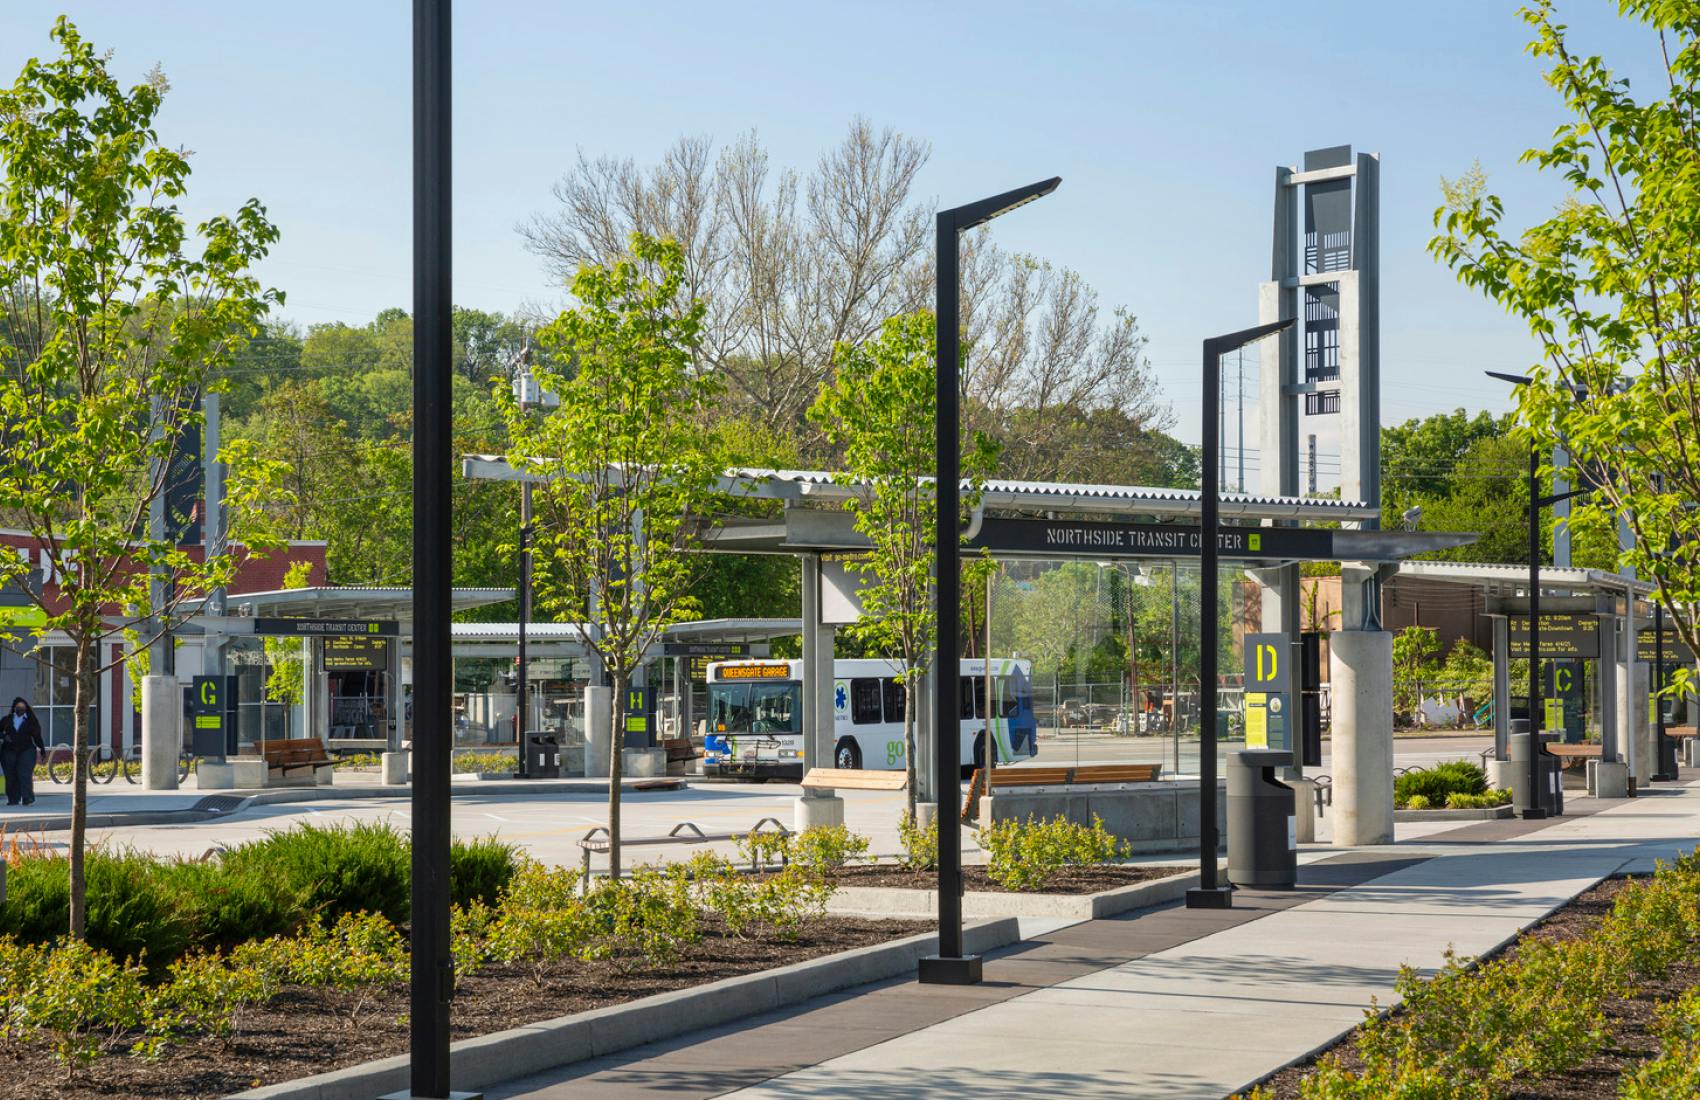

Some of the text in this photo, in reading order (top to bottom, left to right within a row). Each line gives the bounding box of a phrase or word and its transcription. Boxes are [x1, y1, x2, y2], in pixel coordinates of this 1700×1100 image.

[1046, 528, 1124, 546] NORTHSIDE
[1128, 530, 1186, 548] TRANSIT
[1189, 532, 1242, 549] CTER
[722, 665, 788, 679] QUEENSGATE GARAGE
[1256, 644, 1278, 682] D
[1555, 668, 1572, 692] C
[201, 681, 216, 705] G
[630, 691, 643, 710] H
